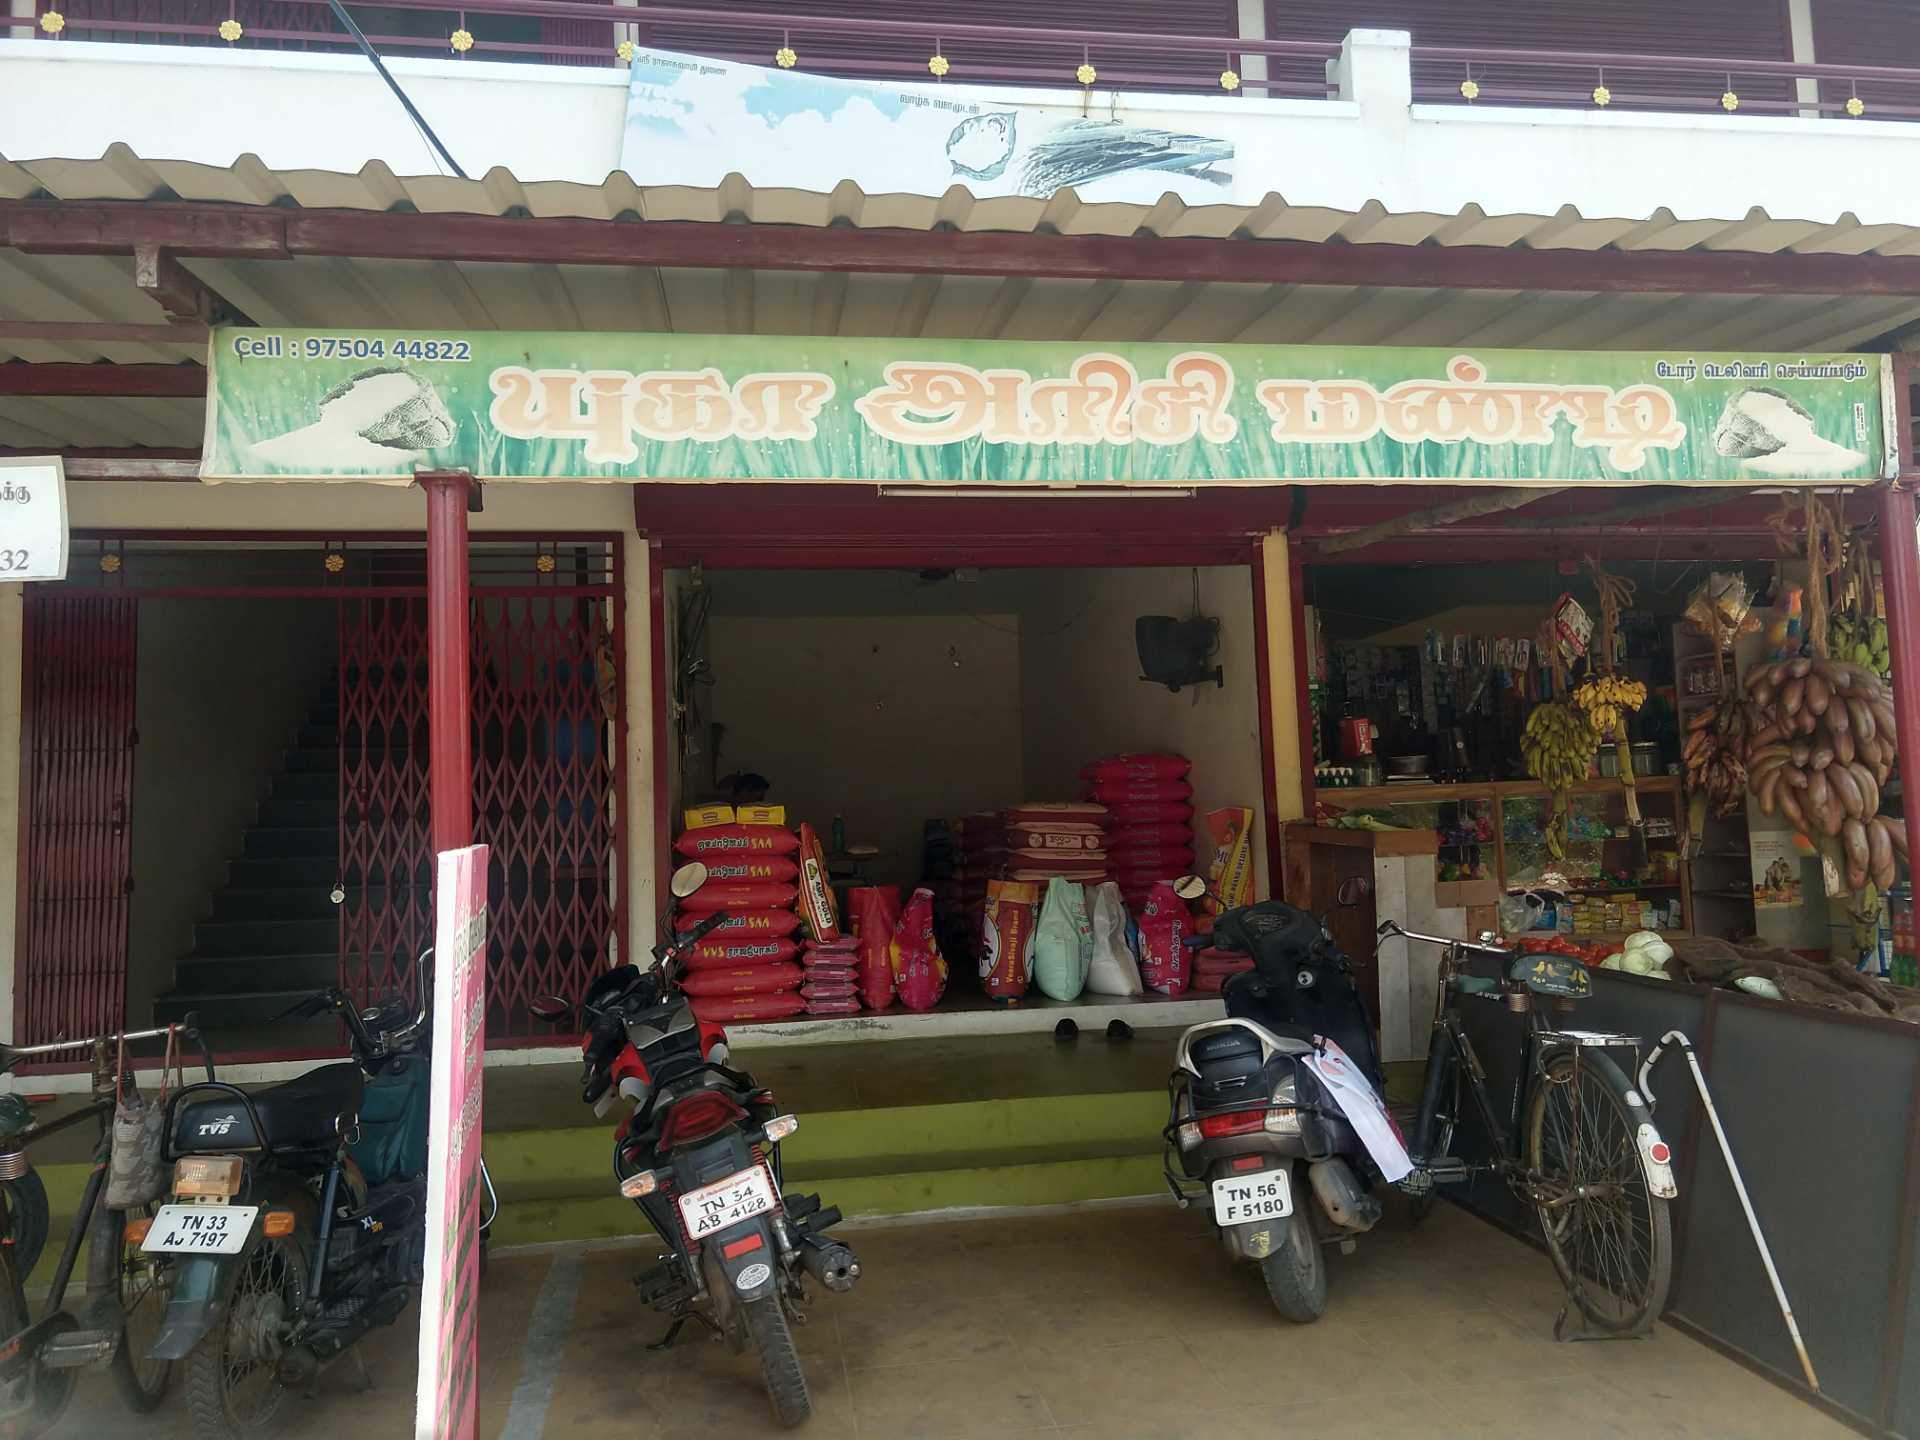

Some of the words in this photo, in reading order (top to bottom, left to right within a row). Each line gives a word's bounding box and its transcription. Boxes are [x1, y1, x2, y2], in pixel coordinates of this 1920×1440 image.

[234, 336, 282, 358] Cell
[304, 337, 385, 360] 97504
[391, 339, 471, 361] 44822
[1656, 359, 1697, 381] டோர்
[1704, 361, 1769, 378] டெலிவரி
[1776, 359, 1867, 381] செய்யப்படும்
[857, 354, 1234, 443] அரிசி
[1258, 356, 1684, 470] மண்டி
[199, 1124, 231, 1136] TVS
[1227, 1187, 1251, 1202] TN
[1257, 1183, 1277, 1198] 56
[697, 1214, 721, 1233] AB
[730, 1197, 767, 1219] 4128
[700, 1196, 725, 1215] TN
[1227, 1207, 1237, 1220] F
[1243, 1198, 1284, 1217] 5180
[181, 1216, 204, 1230] TN
[207, 1216, 228, 1230] 33
[162, 1231, 185, 1247] AJ
[189, 1232, 228, 1247] 7197
